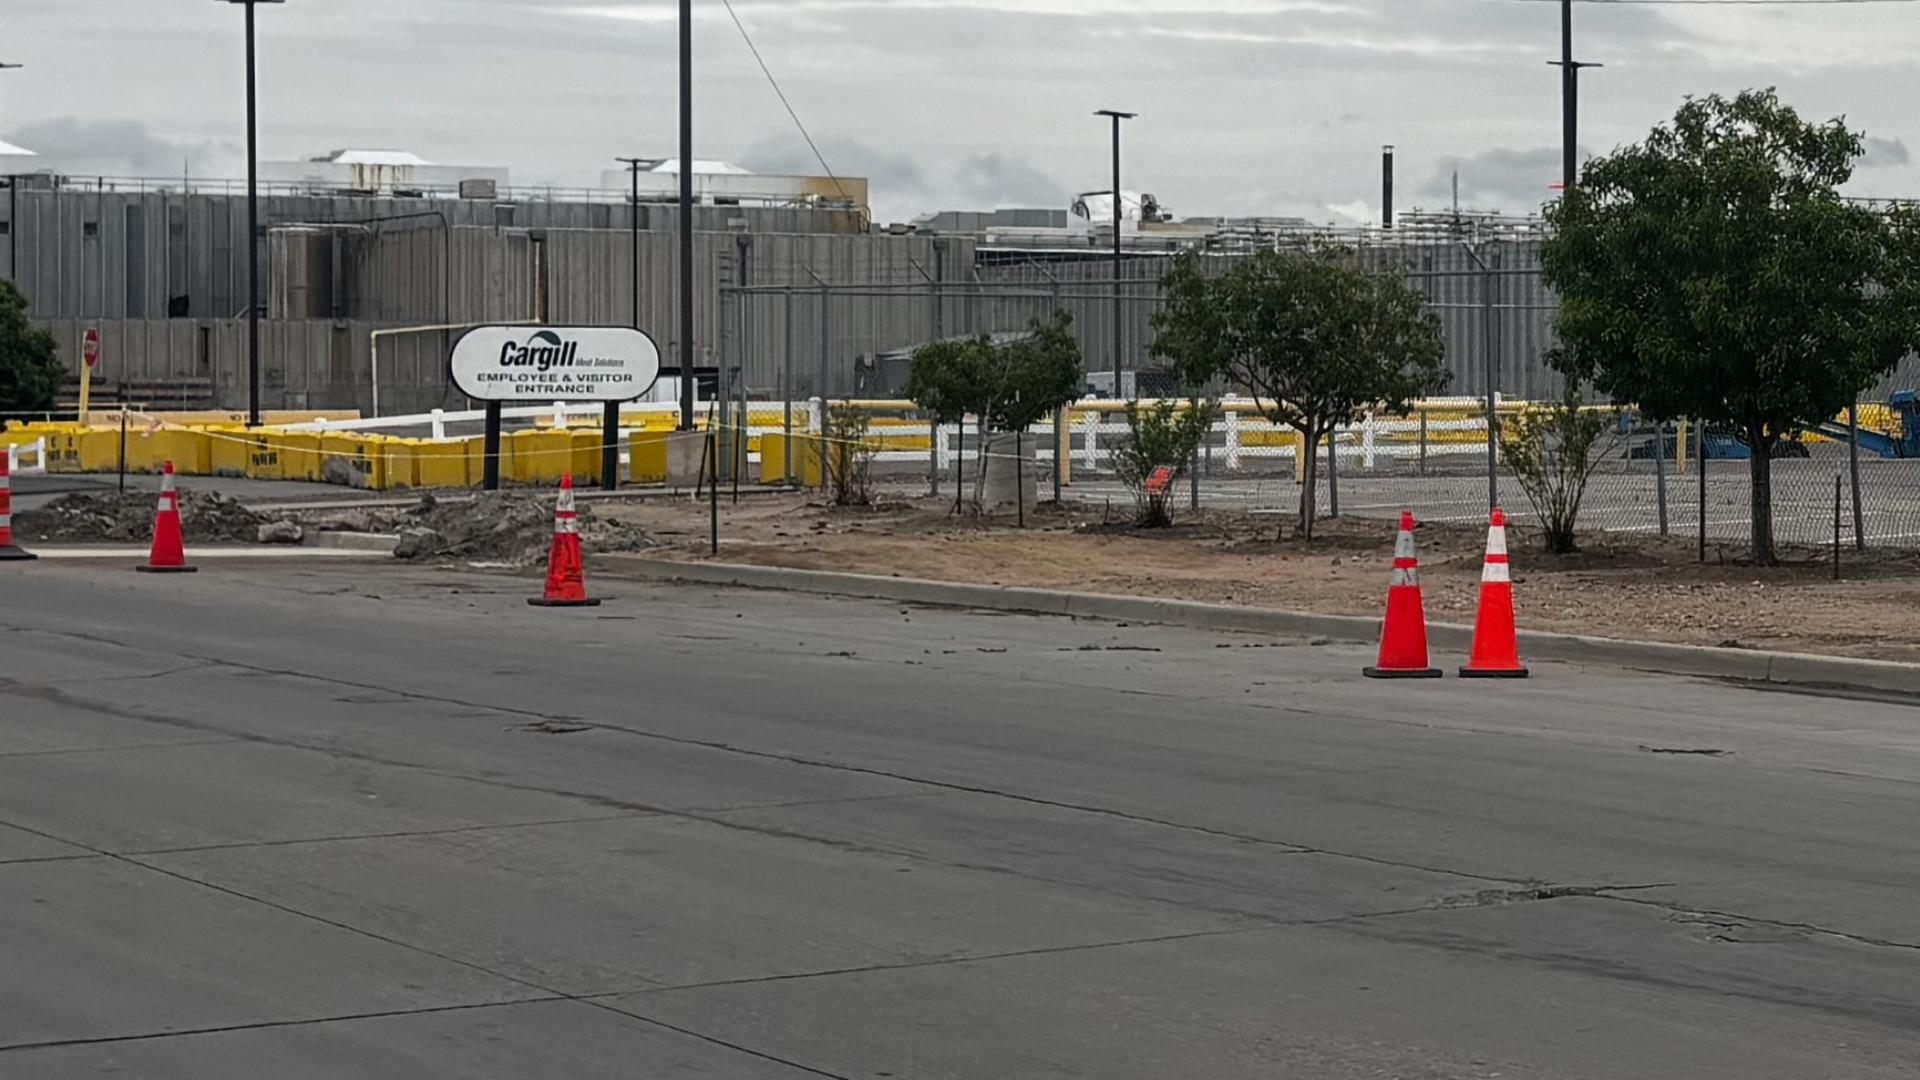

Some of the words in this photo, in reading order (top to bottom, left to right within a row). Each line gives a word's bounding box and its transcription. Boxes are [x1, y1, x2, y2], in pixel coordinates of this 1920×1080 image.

[500, 341, 577, 371] Cargill
[477, 373, 558, 382] EMPLOYEE
[562, 373, 572, 382] &
[577, 373, 633, 382] VISITOR
[515, 384, 595, 393] ENTRANCE
